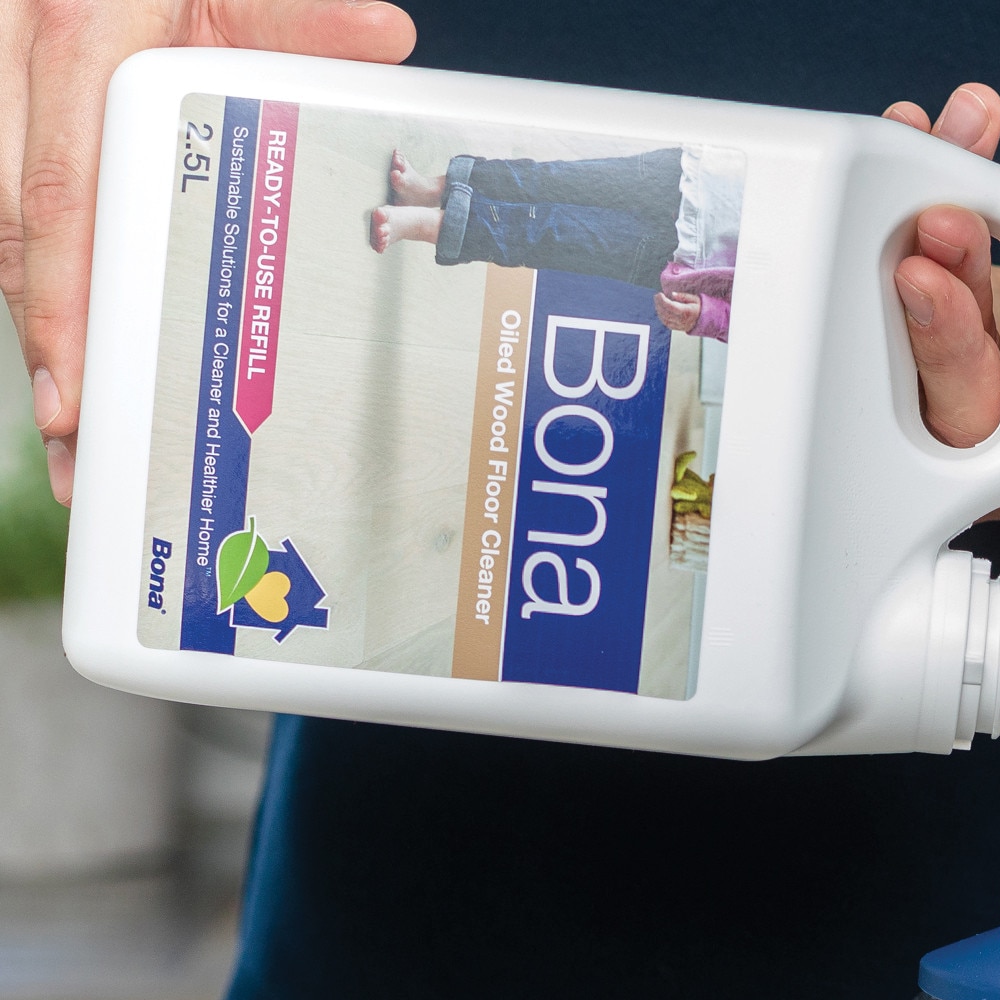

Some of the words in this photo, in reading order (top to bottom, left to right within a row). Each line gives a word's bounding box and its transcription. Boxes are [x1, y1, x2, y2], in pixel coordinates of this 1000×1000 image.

[180, 120, 214, 193] 2.5L
[225, 126, 249, 220] Sustainable
[253, 129, 287, 300] READY-TO-USE
[217, 222, 240, 298] Solutions
[215, 327, 227, 338] a
[216, 301, 232, 325] for
[247, 303, 272, 380] REFILL
[496, 309, 521, 374] Oiled
[208, 342, 230, 405] Cleaner
[207, 408, 221, 438] and
[488, 380, 514, 454] Wood
[200, 443, 221, 515] Healthier
[483, 459, 508, 525] Floor
[520, 314, 651, 620] Bona
[474, 529, 502, 626] Cleaner
